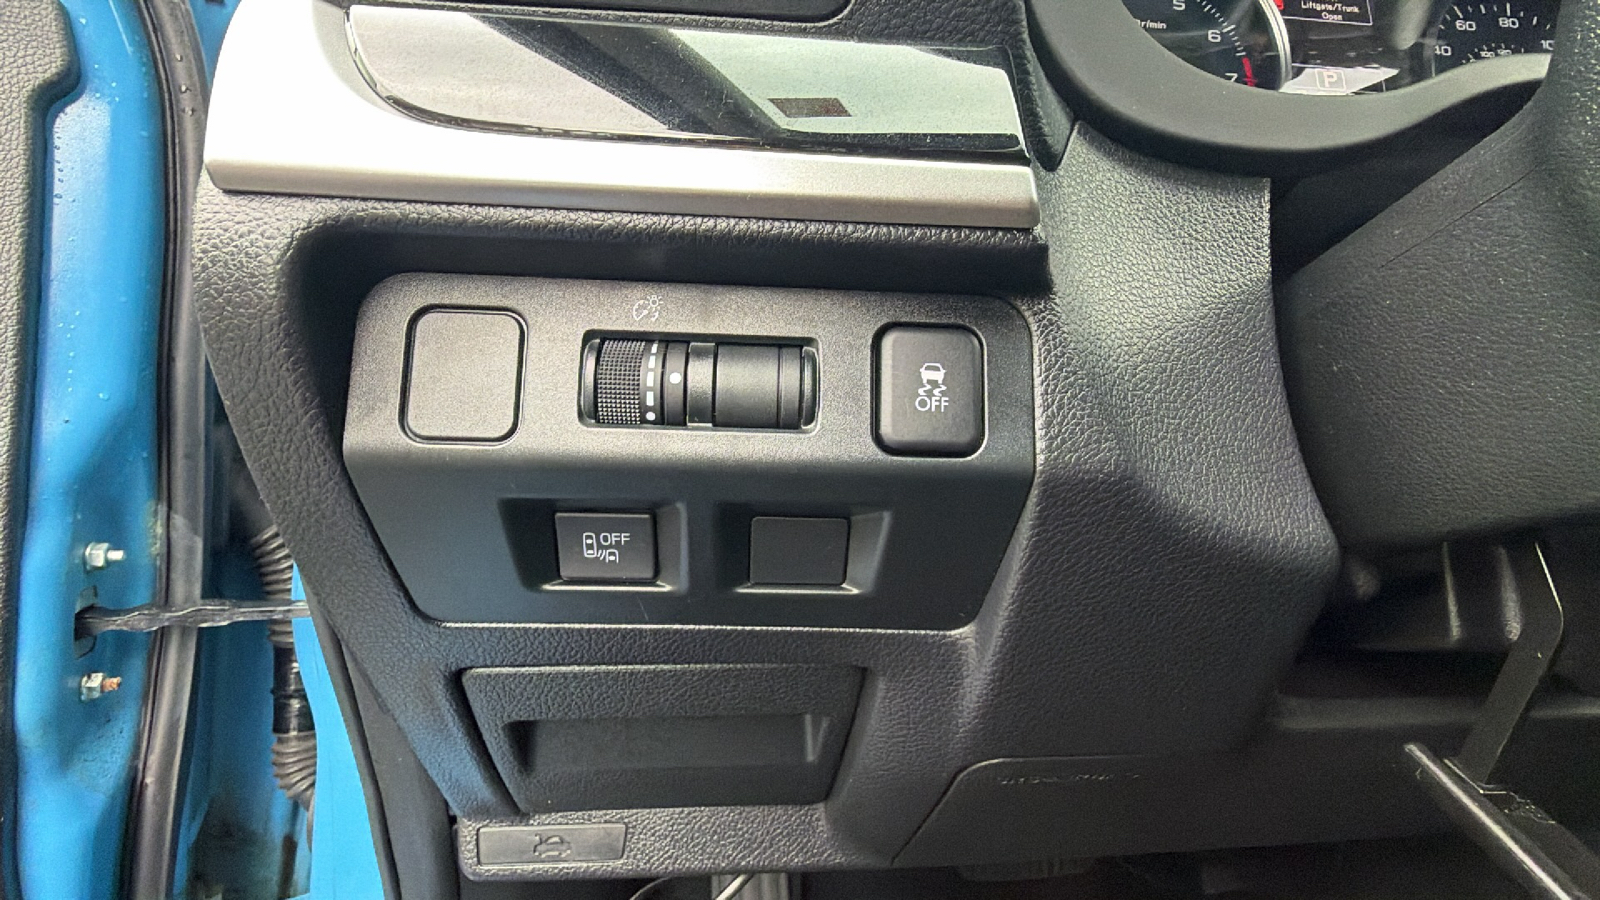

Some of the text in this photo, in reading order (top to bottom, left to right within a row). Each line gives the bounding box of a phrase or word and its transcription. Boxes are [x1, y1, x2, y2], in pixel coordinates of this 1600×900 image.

[1172, 0, 1186, 11] 5
[1301, 1, 1360, 13] Liftgate/Trunk
[1321, 12, 1343, 21] Open
[1455, 20, 1476, 31] 60
[1498, 17, 1519, 29] 80
[1207, 30, 1221, 43] 6
[1224, 72, 1238, 83] 7
[1323, 71, 1338, 88] P
[914, 396, 949, 412] OFF
[600, 532, 631, 546] OFF
